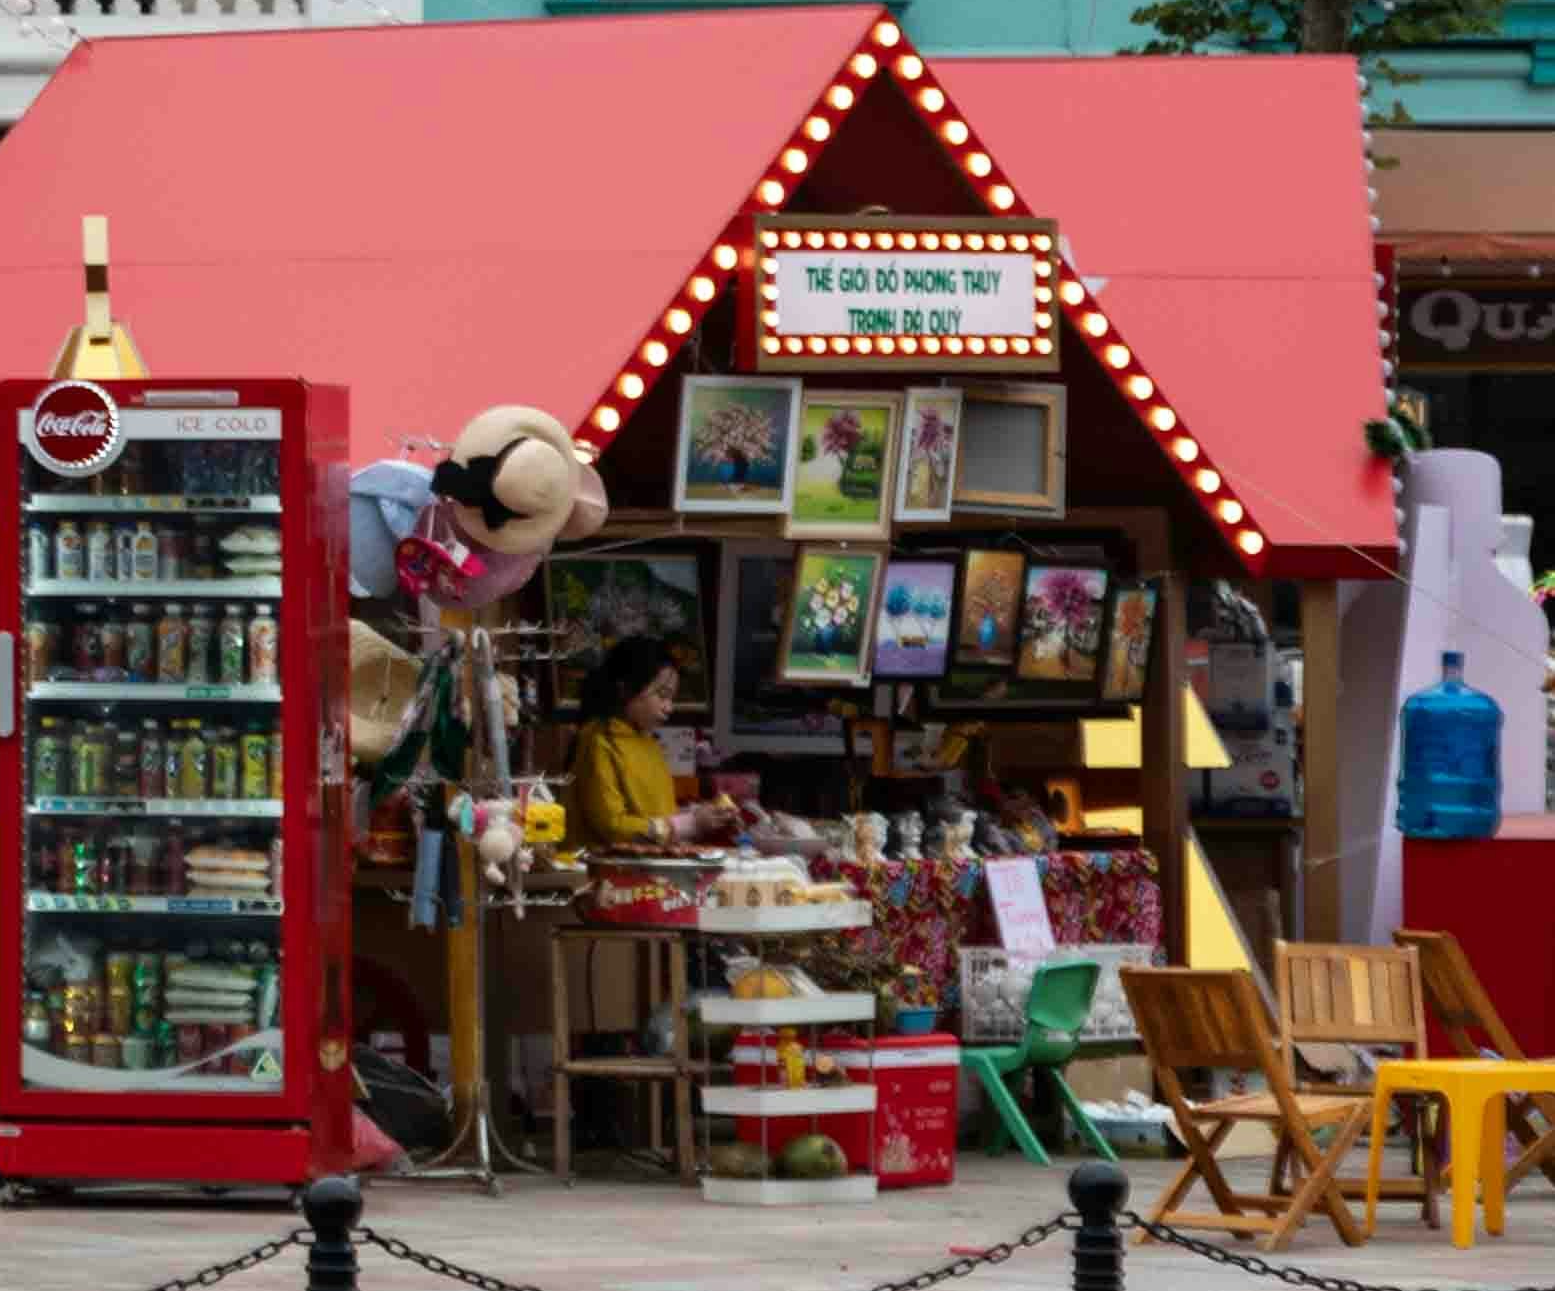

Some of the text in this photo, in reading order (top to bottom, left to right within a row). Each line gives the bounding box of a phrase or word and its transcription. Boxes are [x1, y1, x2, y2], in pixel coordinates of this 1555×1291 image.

[903, 267, 957, 294] PHONG
[846, 308, 897, 334] TRANH
[36, 410, 109, 438] Coca-Cola
[175, 416, 268, 432] ICE COLD
